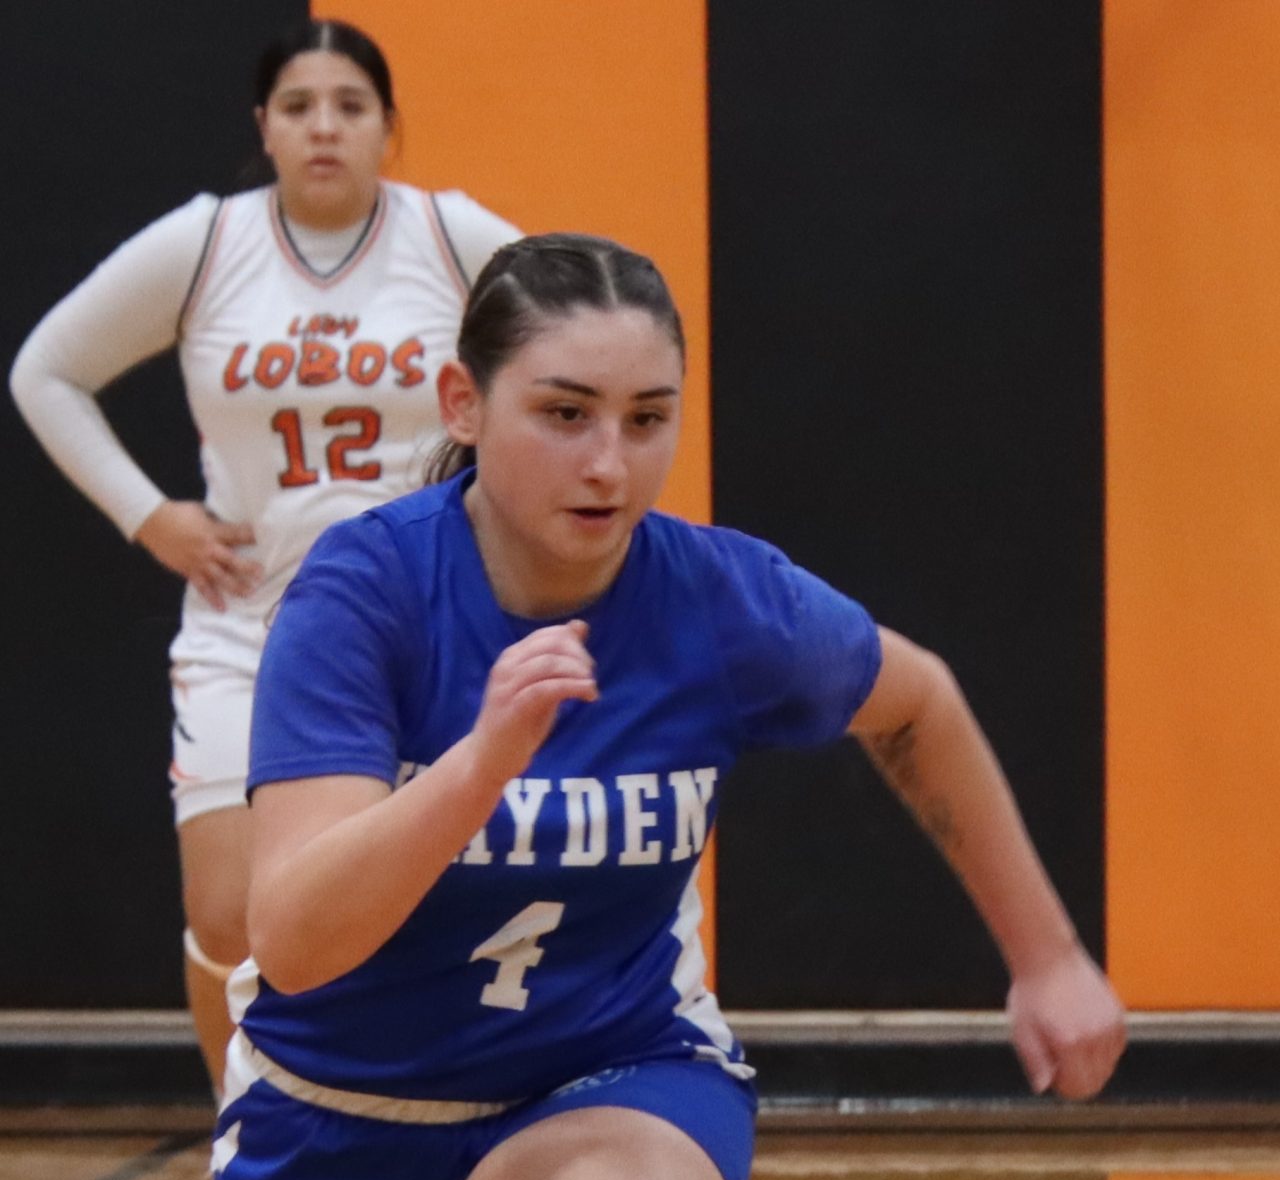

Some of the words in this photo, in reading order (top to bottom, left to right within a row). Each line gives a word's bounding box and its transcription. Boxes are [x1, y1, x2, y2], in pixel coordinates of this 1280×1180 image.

[222, 337, 426, 392] LOBOS
[270, 405, 383, 488] 12
[396, 761, 719, 867] YDEN
[468, 900, 566, 1012] 4
